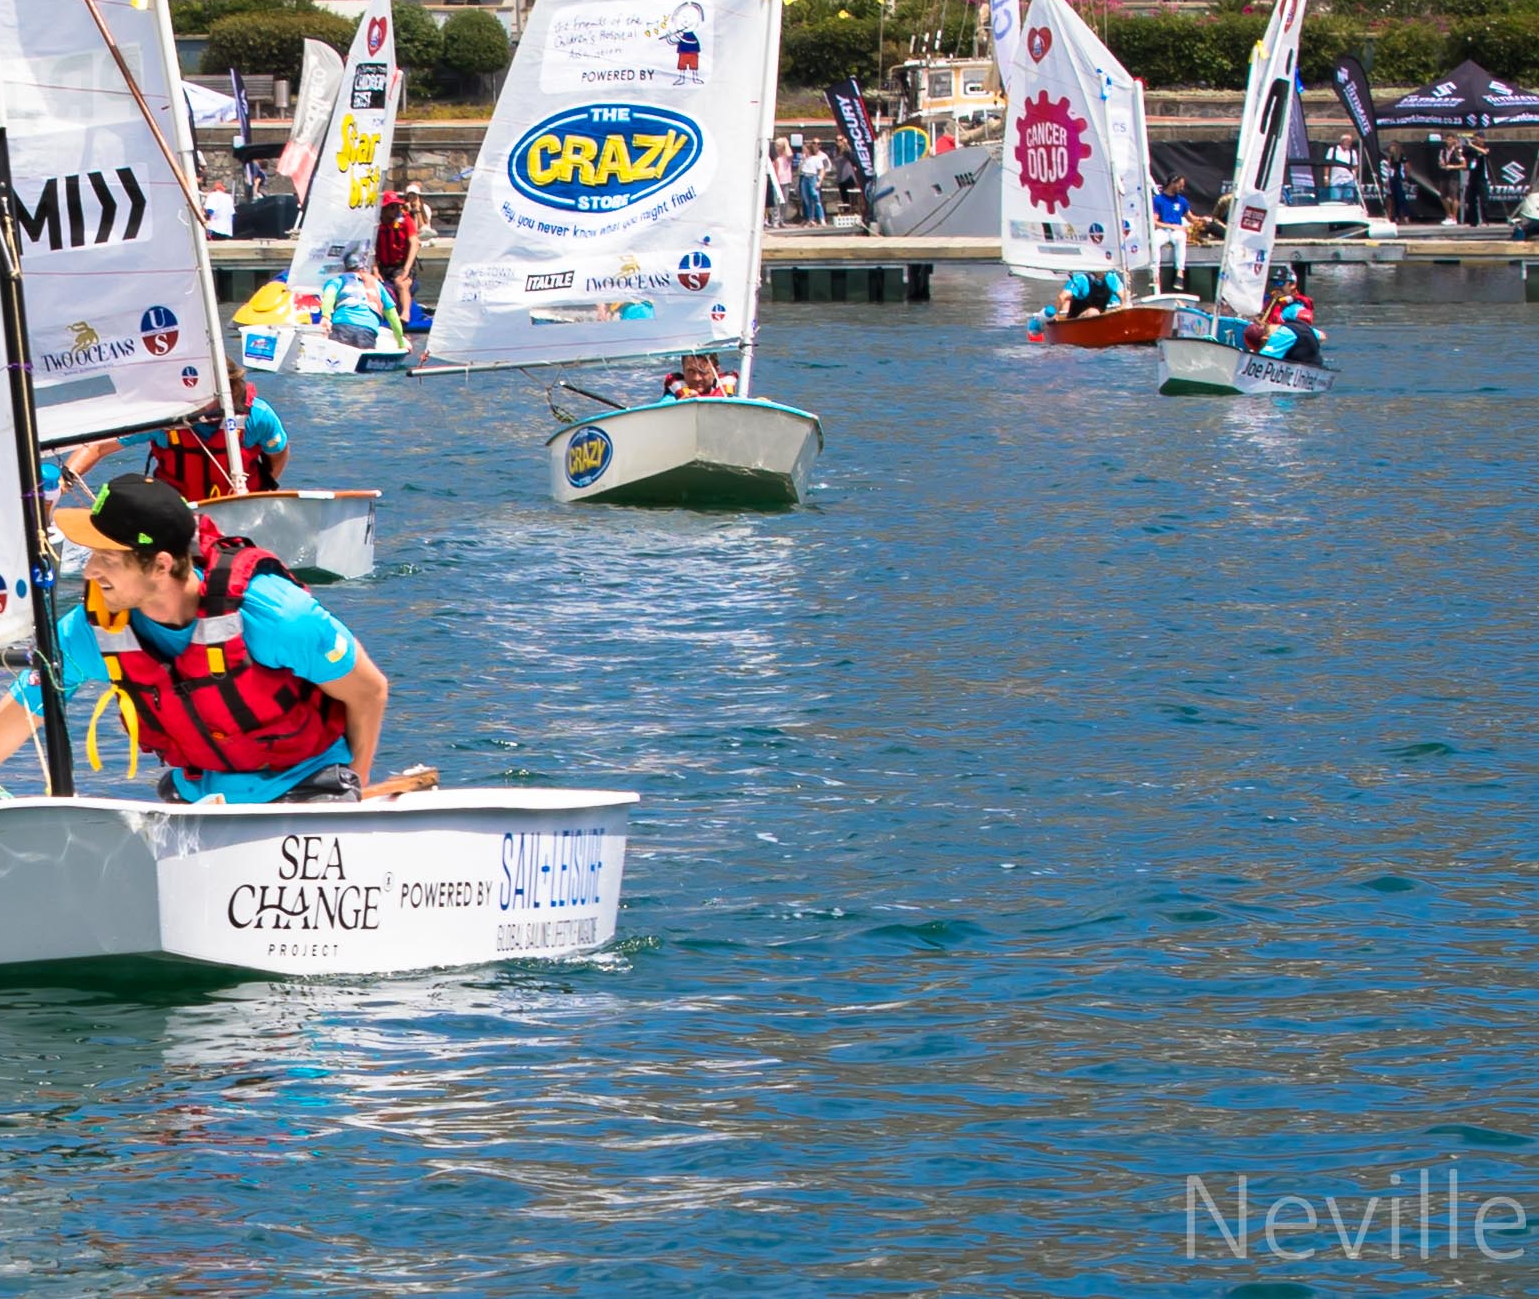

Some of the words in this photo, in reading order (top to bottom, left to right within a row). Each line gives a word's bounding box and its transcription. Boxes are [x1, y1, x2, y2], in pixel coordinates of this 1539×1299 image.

[581, 70, 635, 82] POWERED
[640, 70, 655, 81] BY
[591, 107, 630, 122] THE
[336, 113, 381, 172] Star
[836, 94, 873, 175] MERCURY
[1026, 122, 1067, 147] CANCER
[527, 129, 688, 187] CRAZY
[1028, 147, 1068, 182] DOJO
[519, 215, 534, 229] you
[537, 222, 569, 236] never
[573, 225, 597, 238] know
[671, 186, 697, 208] find!
[527, 272, 573, 291] ITALTILE
[586, 278, 614, 292] TWO
[615, 274, 670, 289] OCEANS
[688, 274, 702, 289] S
[42, 352, 74, 372] TWO
[75, 339, 135, 365] OCEANS
[155, 333, 170, 353] S
[1242, 357, 1261, 378] Joe
[1265, 361, 1293, 386] Public
[569, 437, 606, 475] CRAZY
[279, 835, 346, 881] SEA
[227, 884, 381, 931] CHANGE
[401, 881, 473, 909] POWERED
[476, 880, 492, 907] BY
[268, 943, 339, 957] PROJECT
